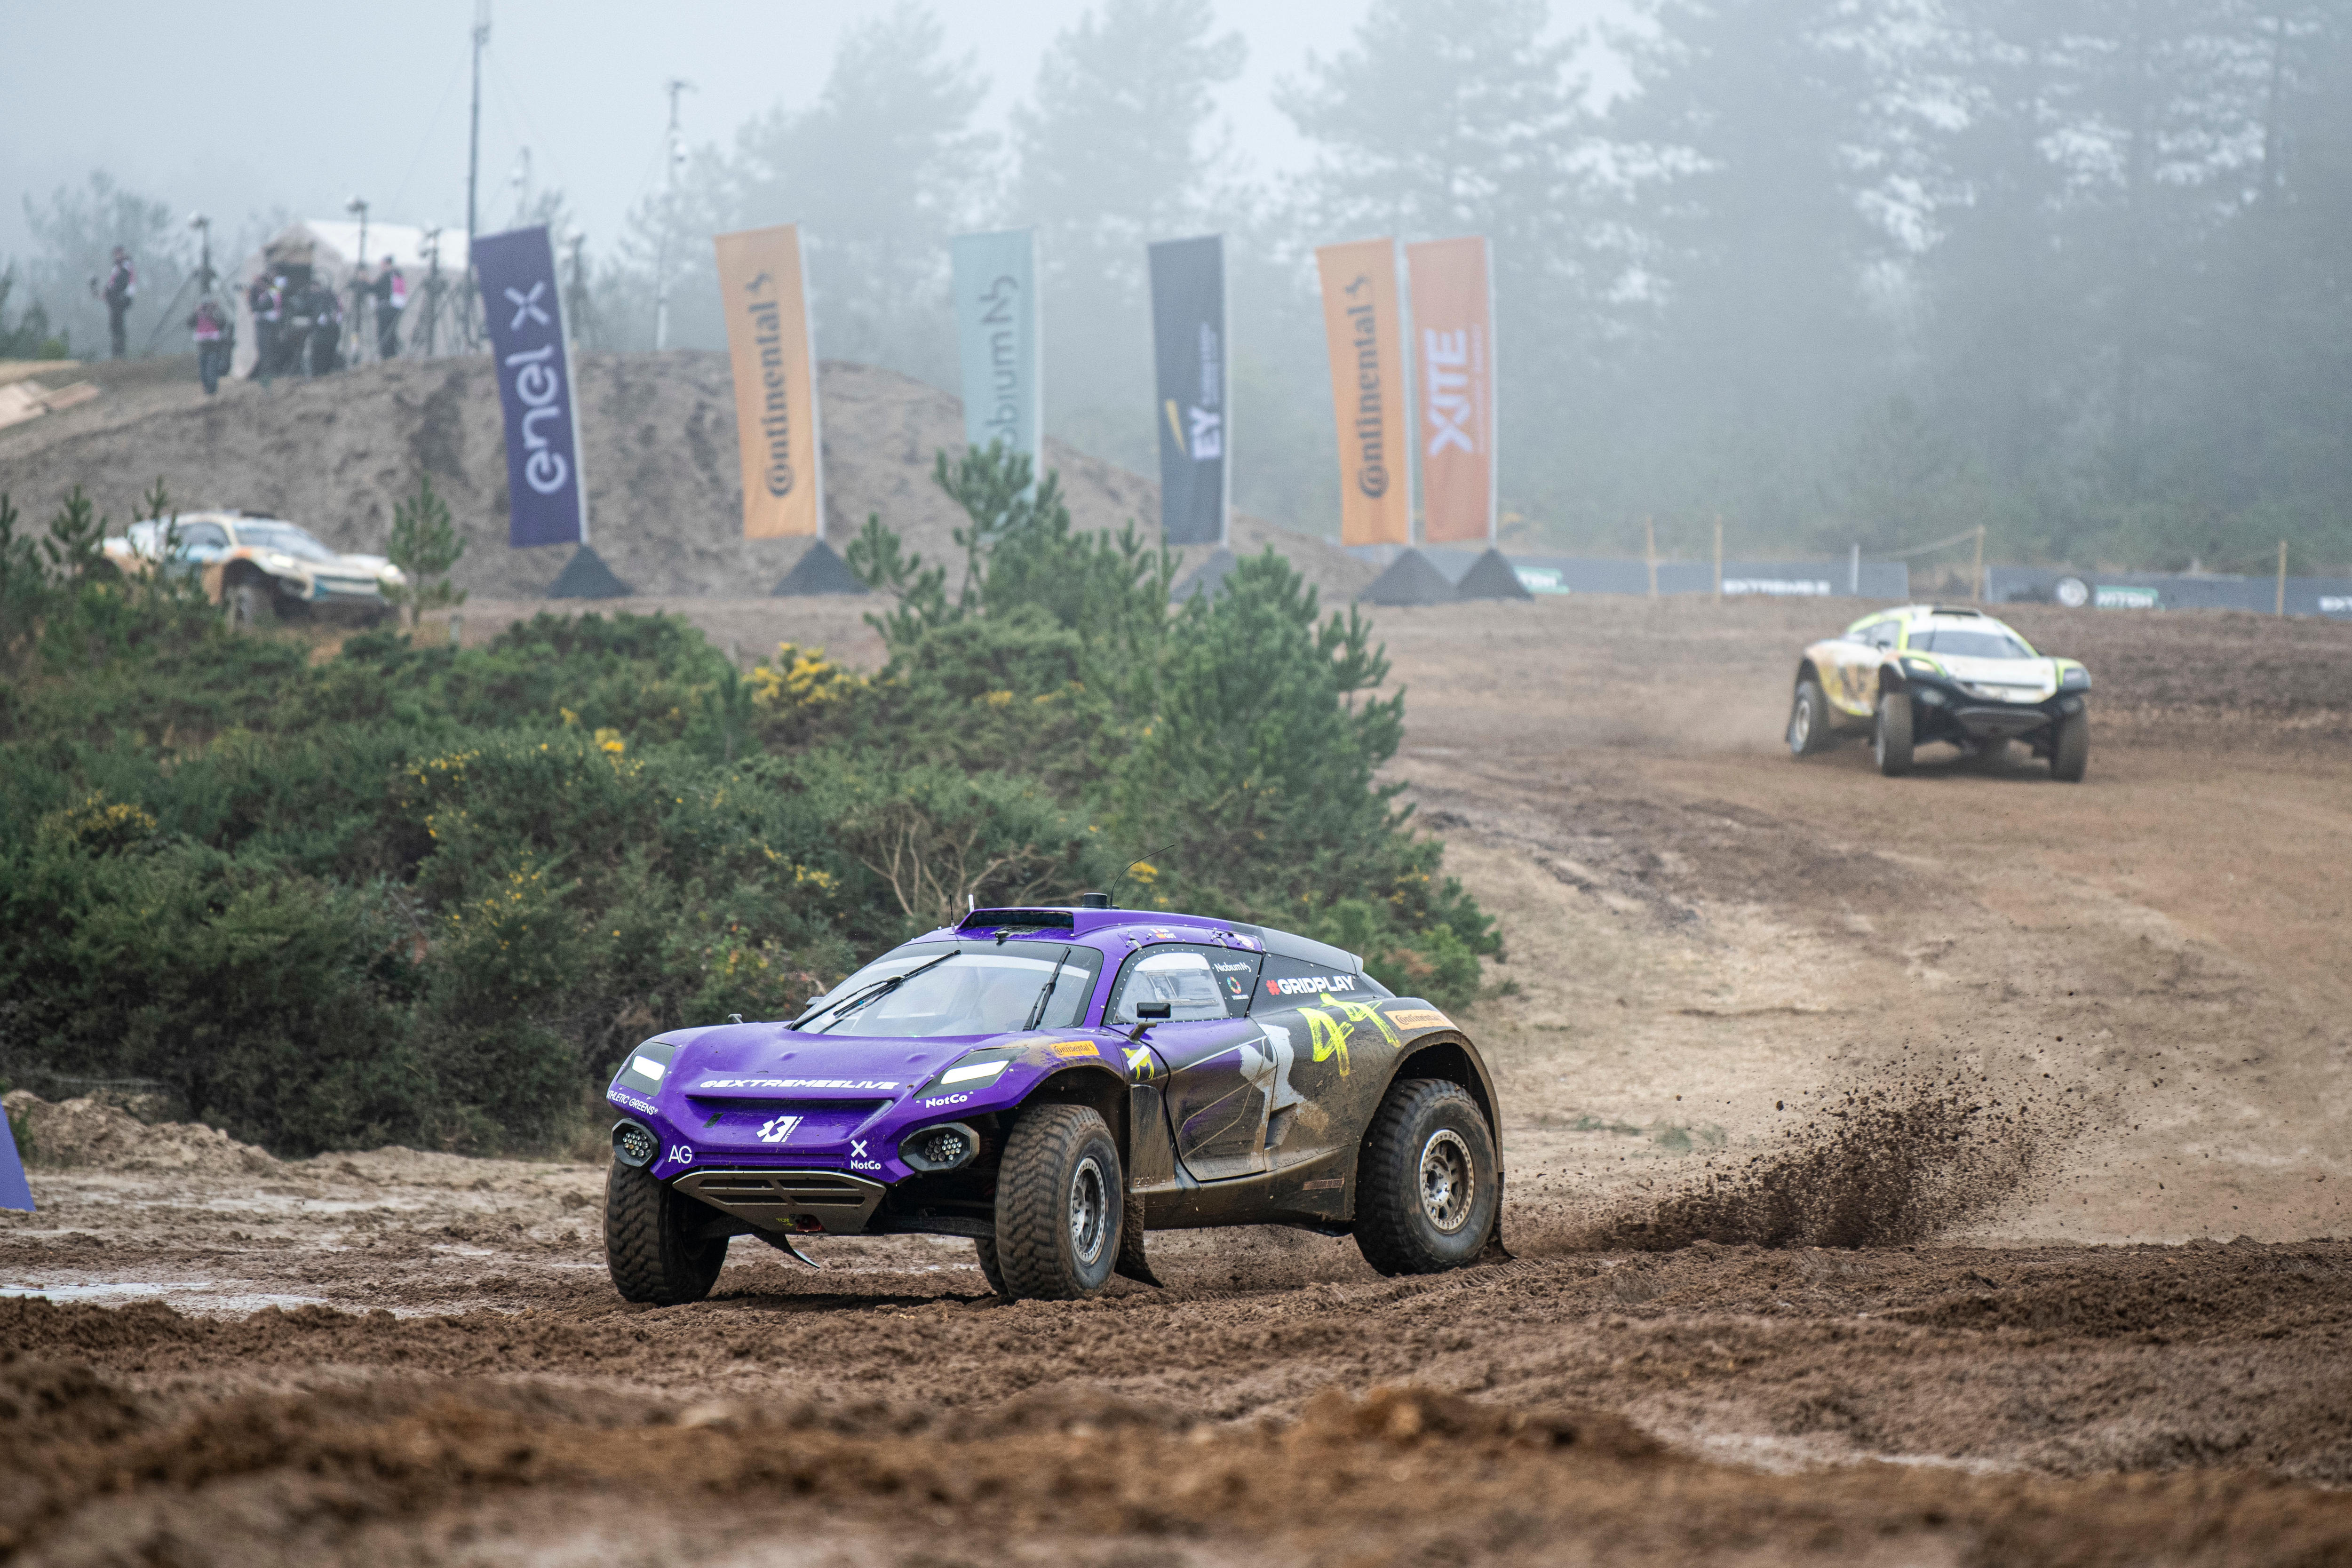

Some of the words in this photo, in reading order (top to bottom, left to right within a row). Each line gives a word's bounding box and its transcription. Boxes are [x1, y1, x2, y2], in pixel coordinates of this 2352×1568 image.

[747, 299, 795, 498] Continental
[1346, 304, 1390, 499] Continental
[1424, 328, 1473, 456] XITE
[504, 344, 565, 494] enel
[1188, 405, 1222, 460] EY
[1266, 976, 1355, 995] #GRIDPLAY
[1054, 1043, 1090, 1055] Continental
[700, 1080, 899, 1090] @EXTREMEELIVE
[606, 1090, 629, 1105] ATHLETIC
[926, 1094, 968, 1108] NotCo
[668, 1145, 692, 1164] AG
[850, 1160, 881, 1170] NotCo
